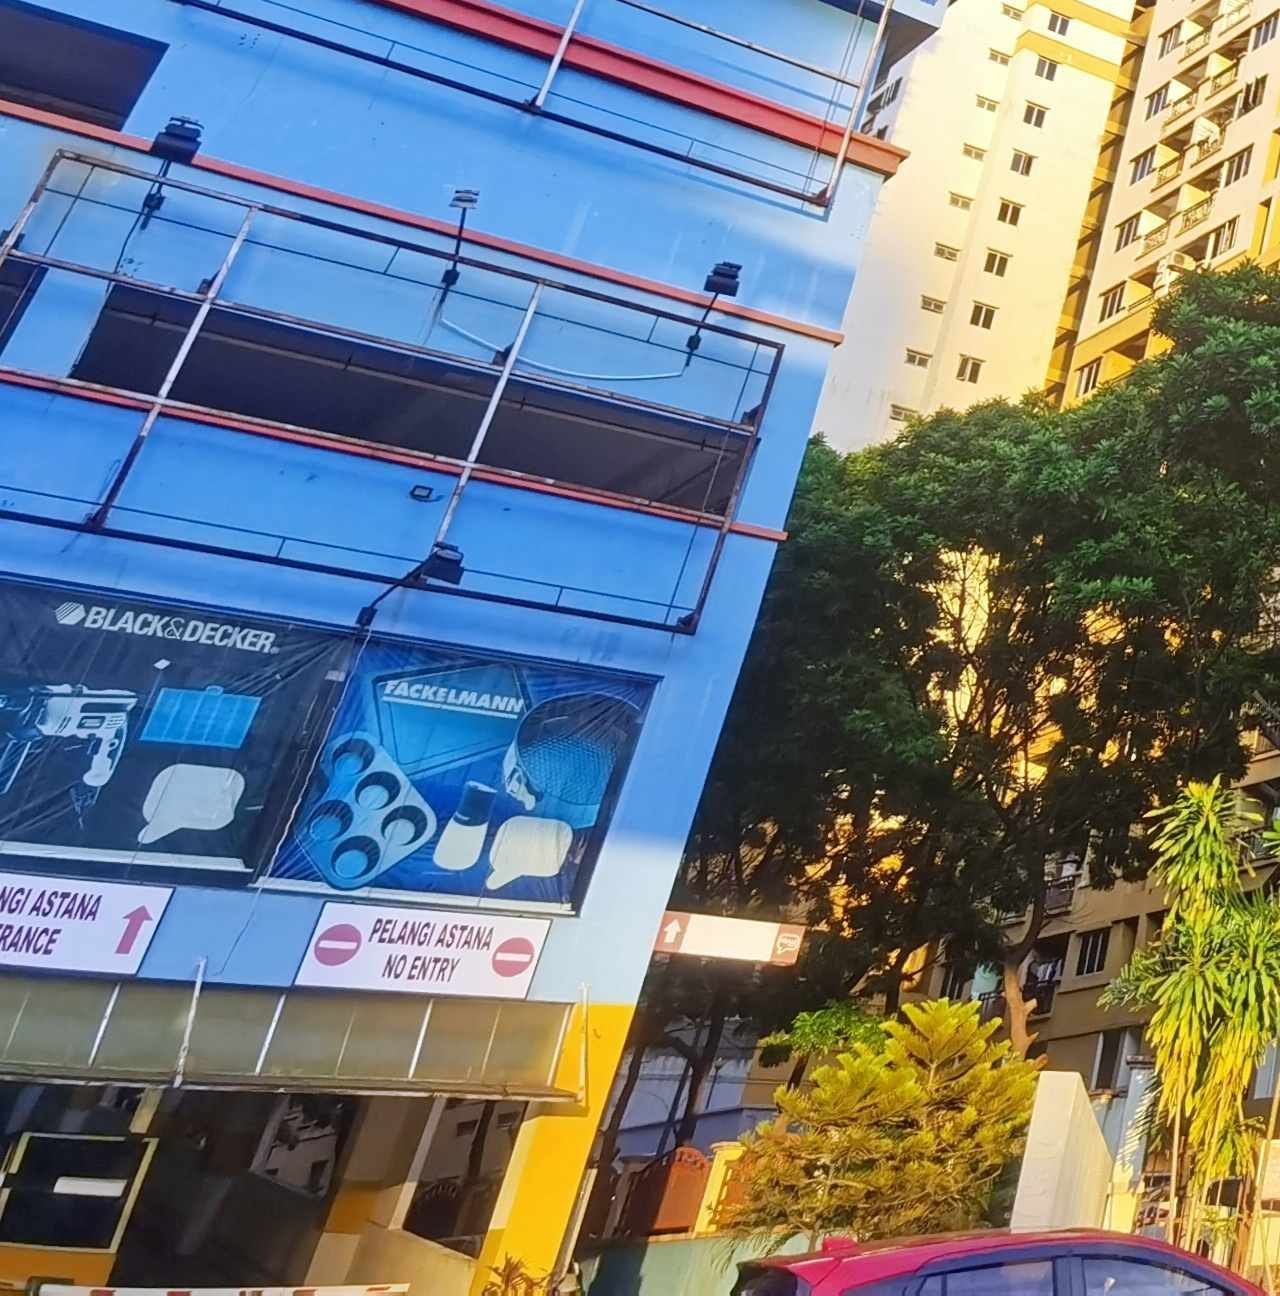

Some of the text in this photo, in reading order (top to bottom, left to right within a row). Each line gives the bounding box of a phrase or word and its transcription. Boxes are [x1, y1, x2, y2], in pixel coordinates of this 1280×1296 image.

[383, 680, 525, 713] FACKELMANN
[28, 889, 104, 921] ASTANA
[0, 923, 62, 955] RANCE
[368, 918, 495, 951] PELANGI ASTANA
[381, 955, 461, 983] NO ENTRY
